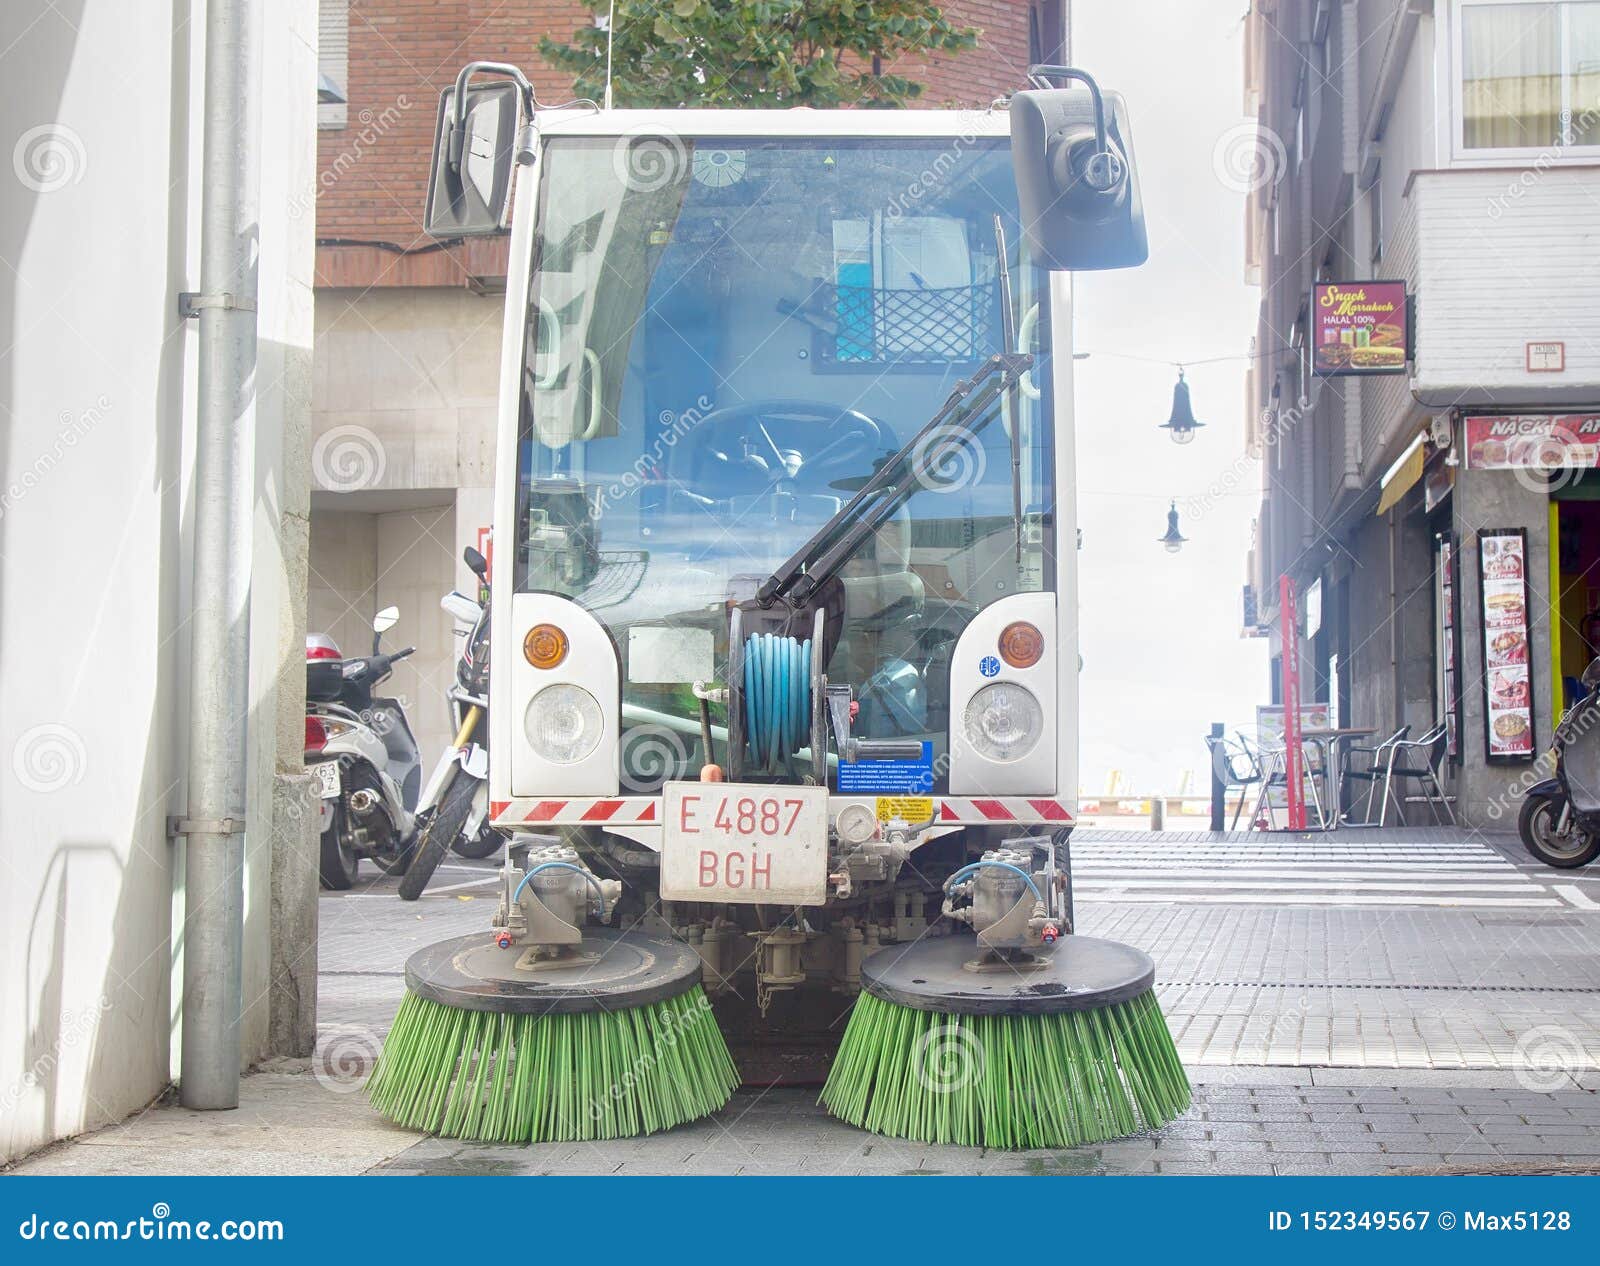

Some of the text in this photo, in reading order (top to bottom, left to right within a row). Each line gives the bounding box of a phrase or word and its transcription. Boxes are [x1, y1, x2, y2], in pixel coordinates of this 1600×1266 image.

[1320, 285, 1366, 307] Snack
[1333, 300, 1394, 316] Marrakech
[1323, 315, 1376, 324] HALAL 100%
[681, 796, 804, 836] E 4887
[698, 850, 772, 890] BGH
